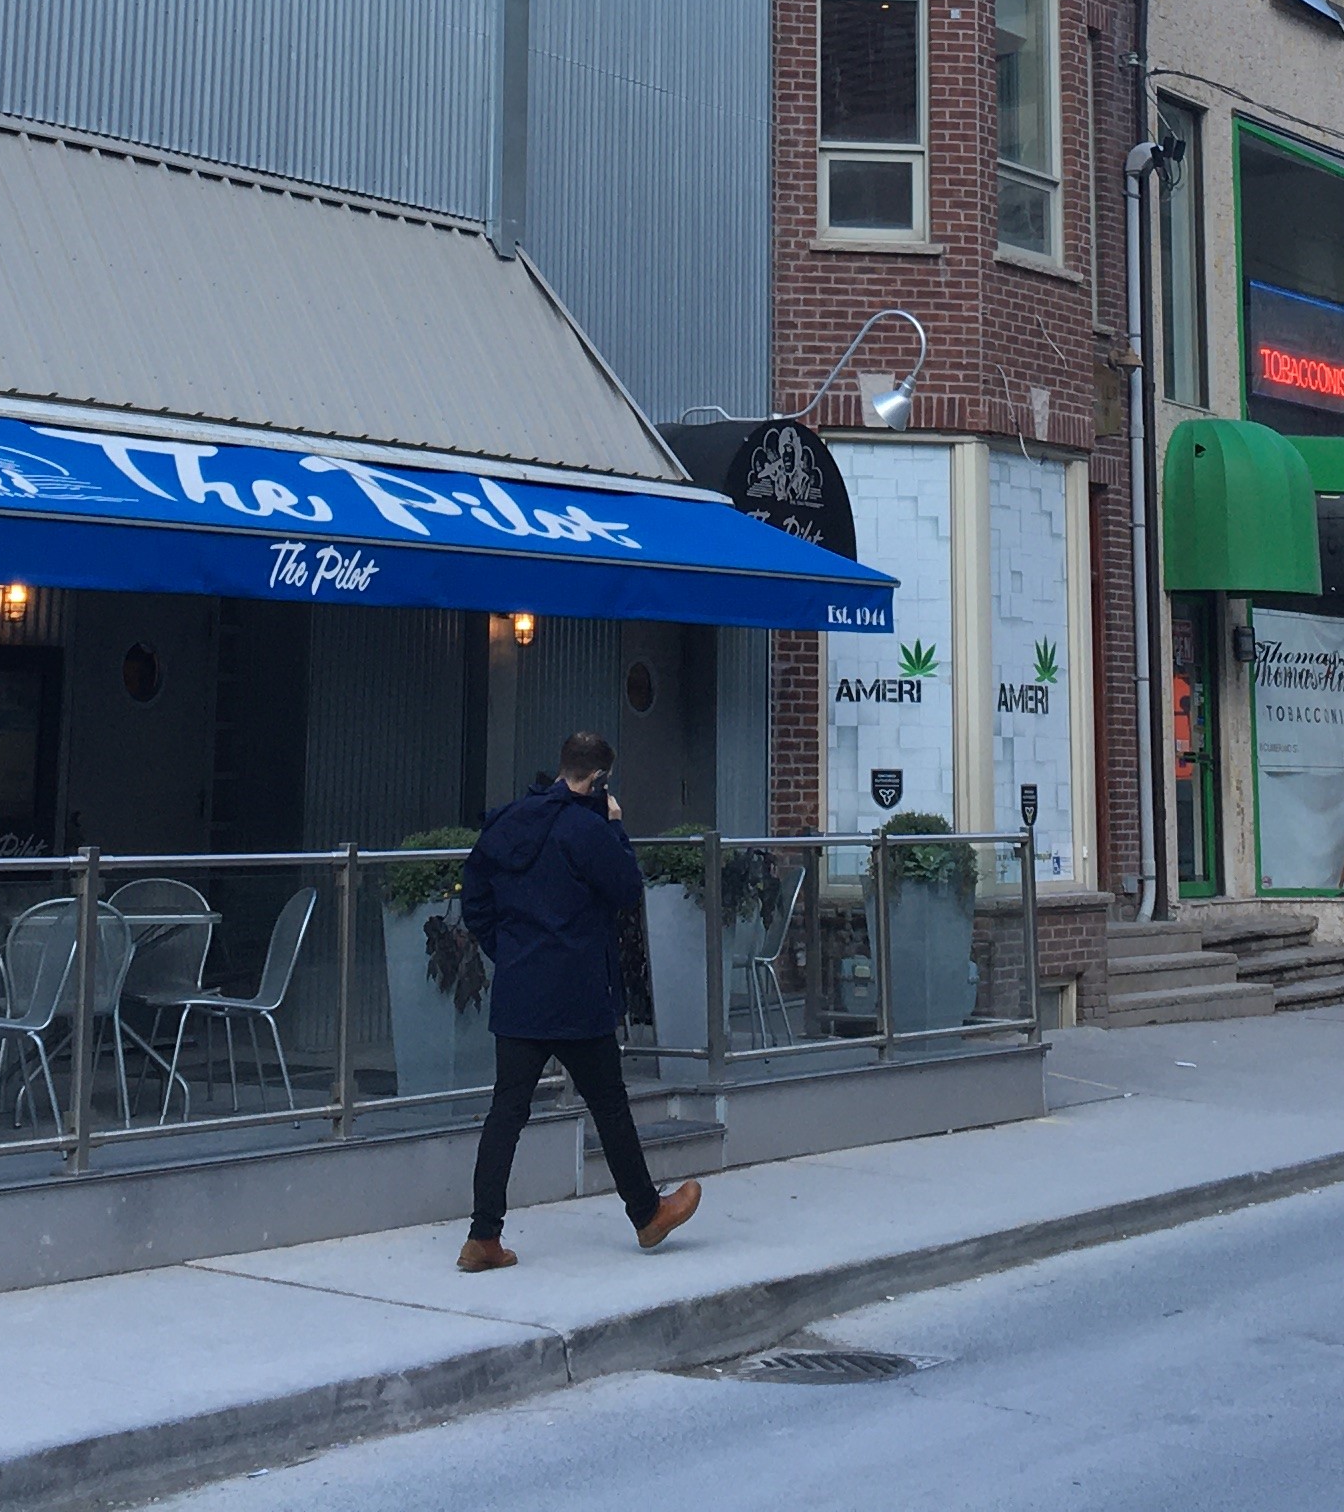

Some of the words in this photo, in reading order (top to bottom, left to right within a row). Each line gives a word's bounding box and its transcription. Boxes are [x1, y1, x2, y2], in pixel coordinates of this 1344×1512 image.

[31, 426, 334, 523] The
[299, 455, 643, 550] Pilot
[270, 540, 308, 586] The
[311, 545, 380, 595] Pilot
[828, 605, 852, 625] Est.
[856, 607, 886, 626] 1944
[835, 678, 922, 704] AMERI
[997, 683, 1050, 715] AMERI
